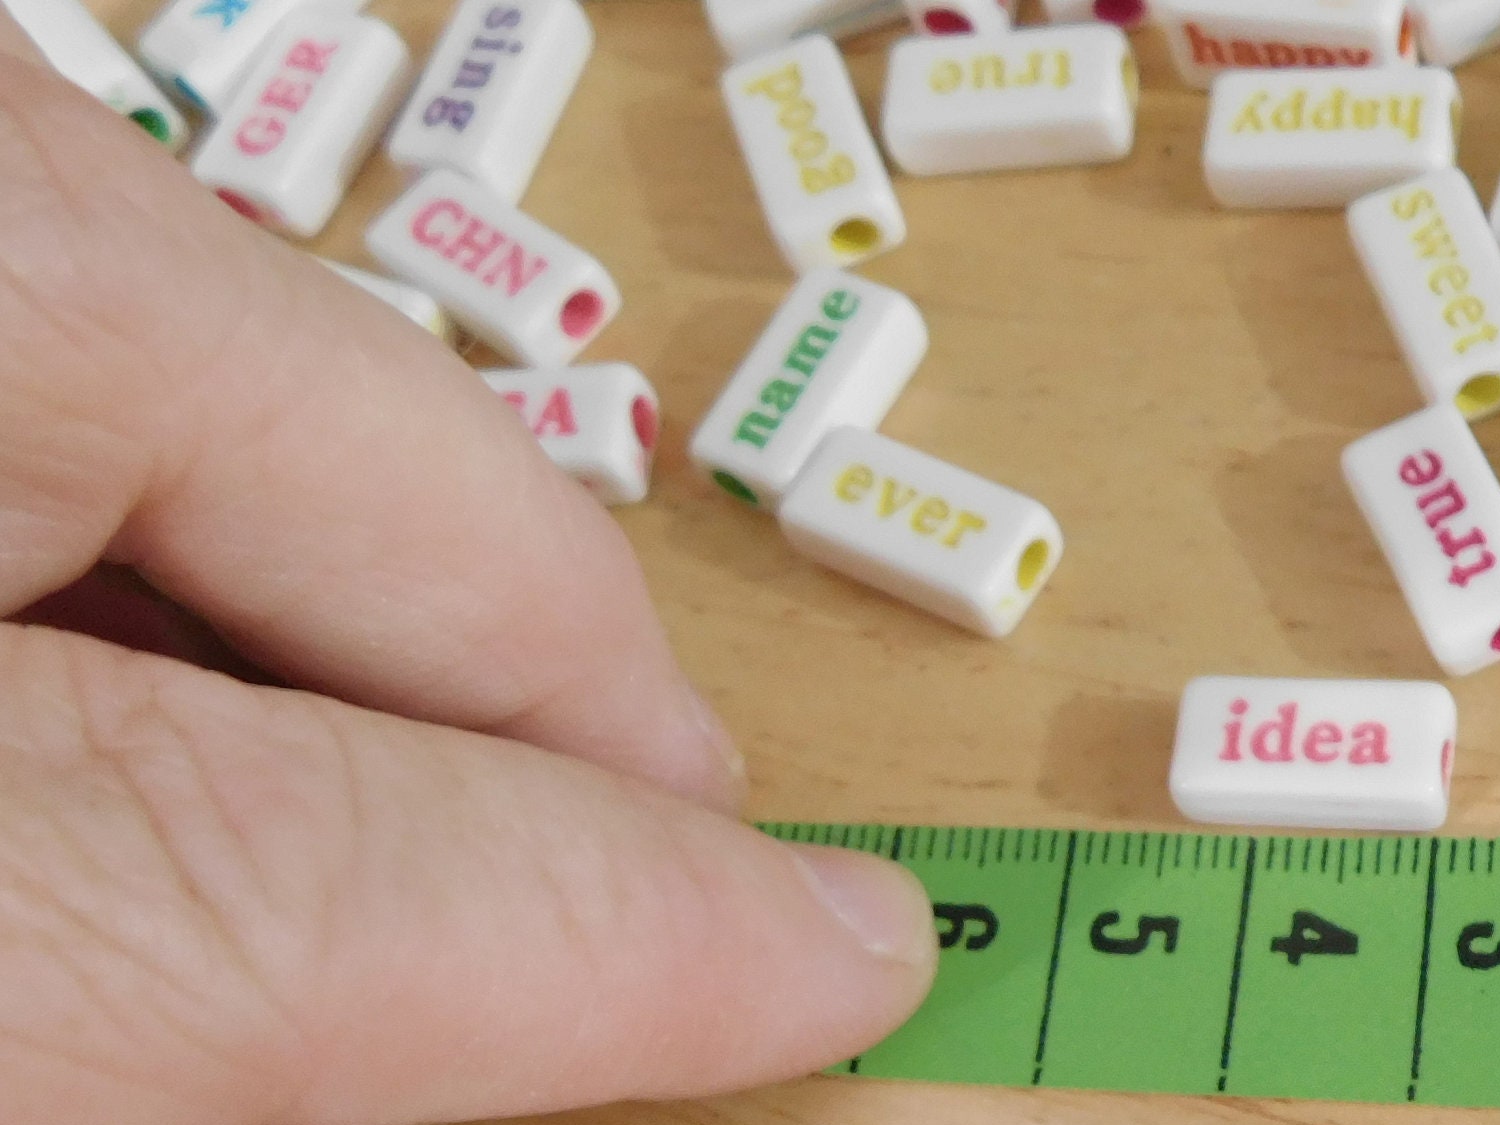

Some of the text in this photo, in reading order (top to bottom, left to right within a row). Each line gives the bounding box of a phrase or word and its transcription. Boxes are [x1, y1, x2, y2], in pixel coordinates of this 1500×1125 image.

[234, 37, 338, 157] GER
[423, 6, 522, 132] sing
[929, 50, 1074, 94] true
[1230, 87, 1424, 142] happy
[743, 61, 857, 197] good
[410, 198, 549, 297] CHN
[1391, 187, 1499, 355] sweet
[731, 288, 859, 450] name
[832, 462, 988, 550] ever
[1398, 448, 1496, 588] true
[1218, 698, 1392, 766] idea
[933, 903, 999, 951] 6
[1089, 910, 1180, 956] 5
[1270, 909, 1359, 966] 4
